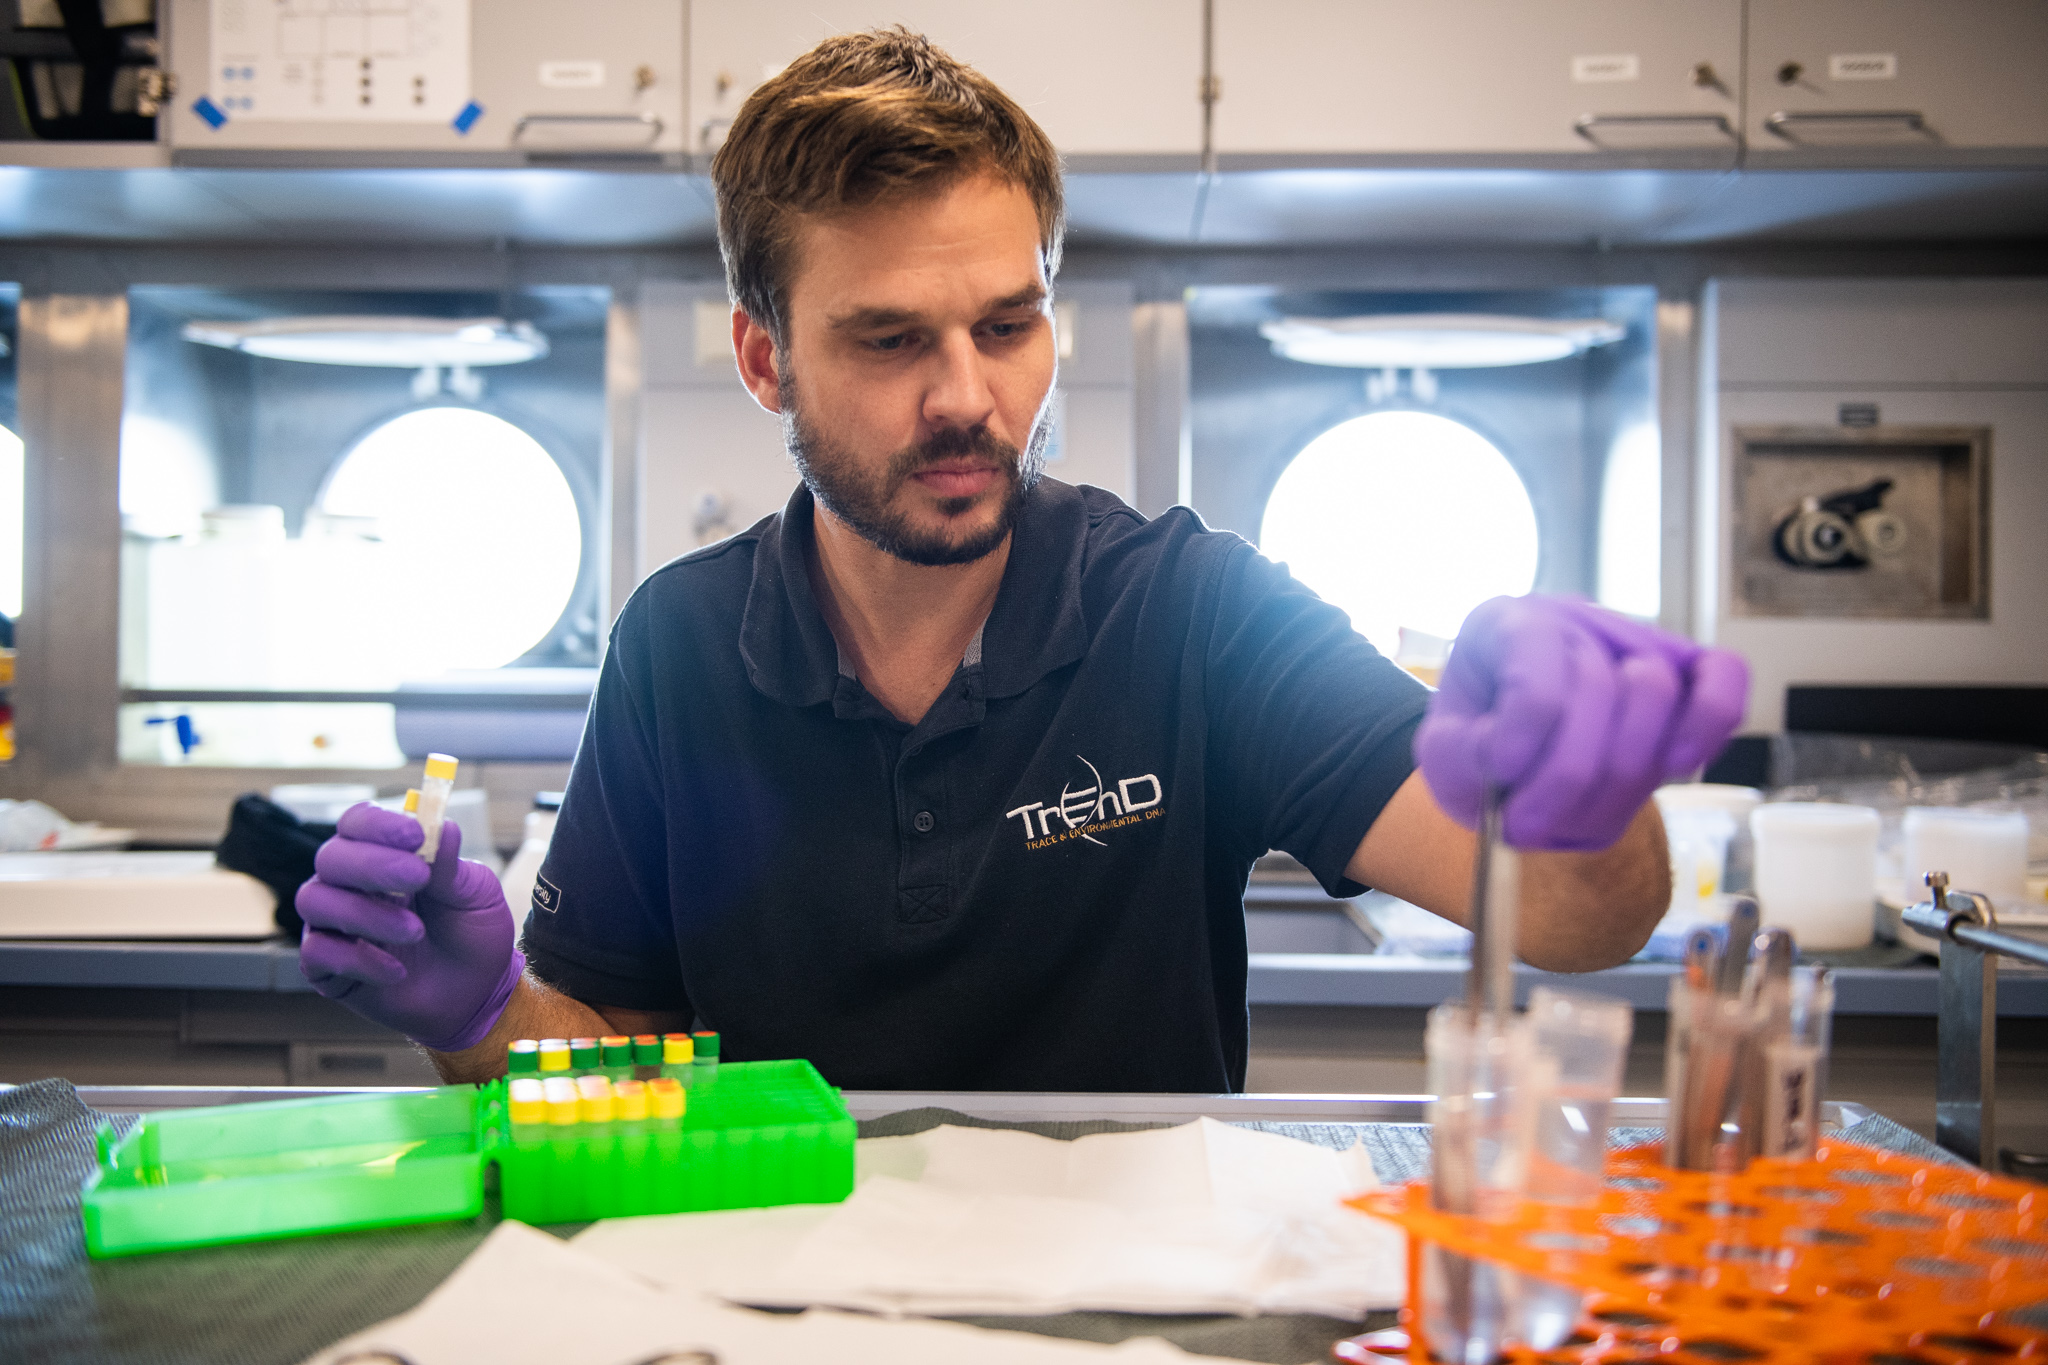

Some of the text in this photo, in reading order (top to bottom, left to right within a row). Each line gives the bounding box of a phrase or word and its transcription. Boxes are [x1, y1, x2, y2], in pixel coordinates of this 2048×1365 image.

[1025, 807, 1166, 851] TRACE & ENVIRONMENTAL DNA
